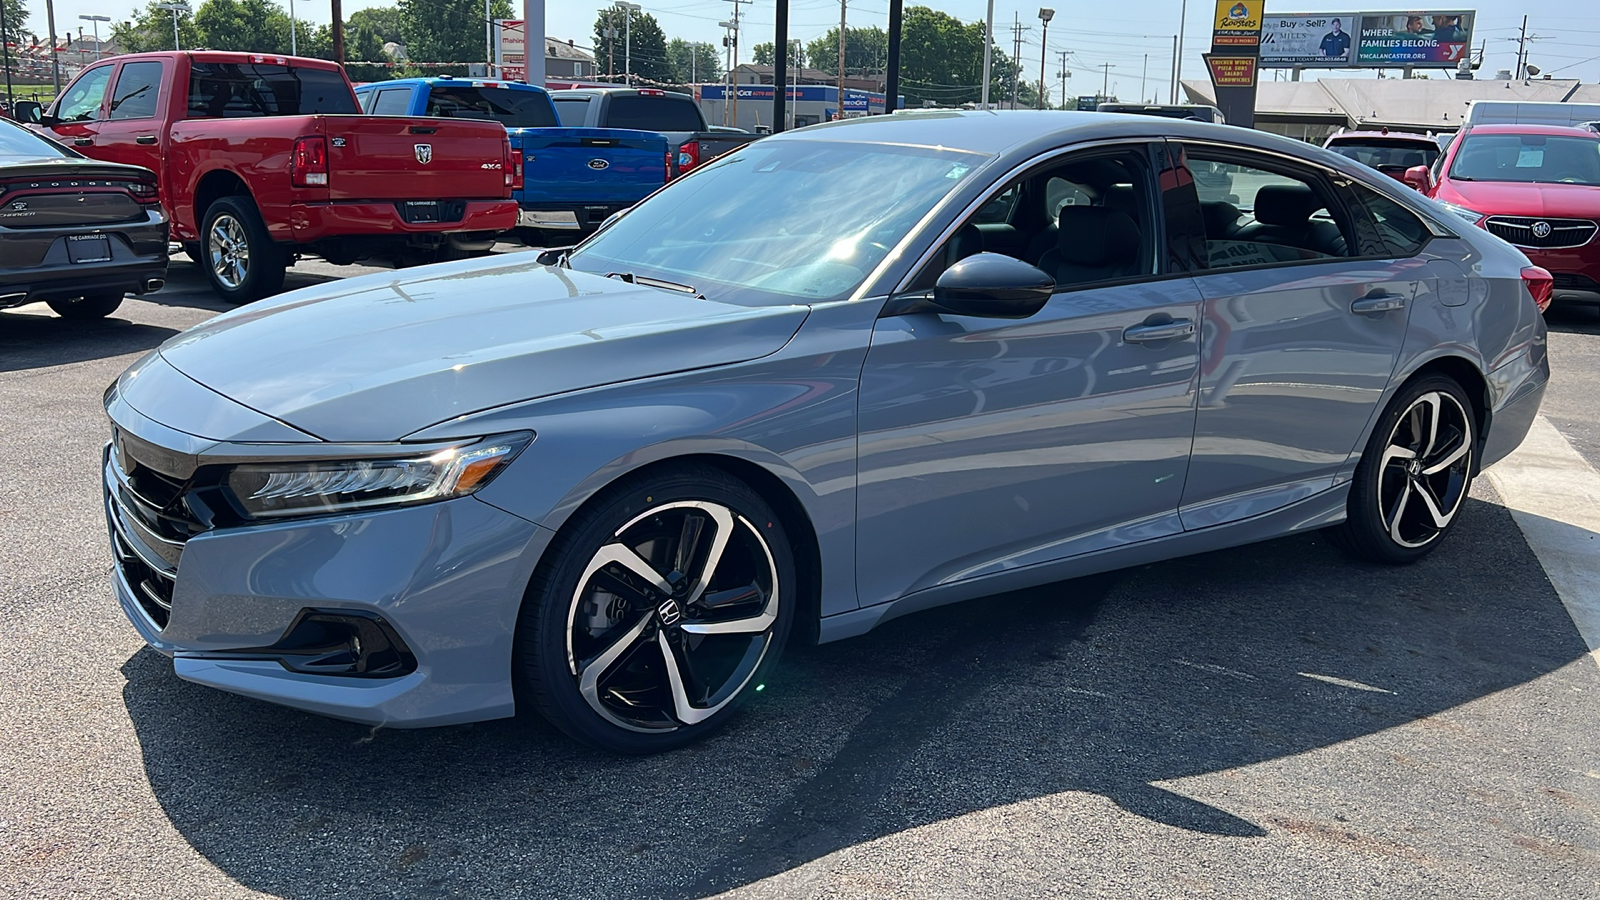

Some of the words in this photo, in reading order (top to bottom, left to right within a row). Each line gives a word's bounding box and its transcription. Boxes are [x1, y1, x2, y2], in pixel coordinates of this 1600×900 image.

[1220, 17, 1256, 28] Roosters
[1280, 20, 1297, 29] Buy
[1306, 19, 1326, 27] Sell?
